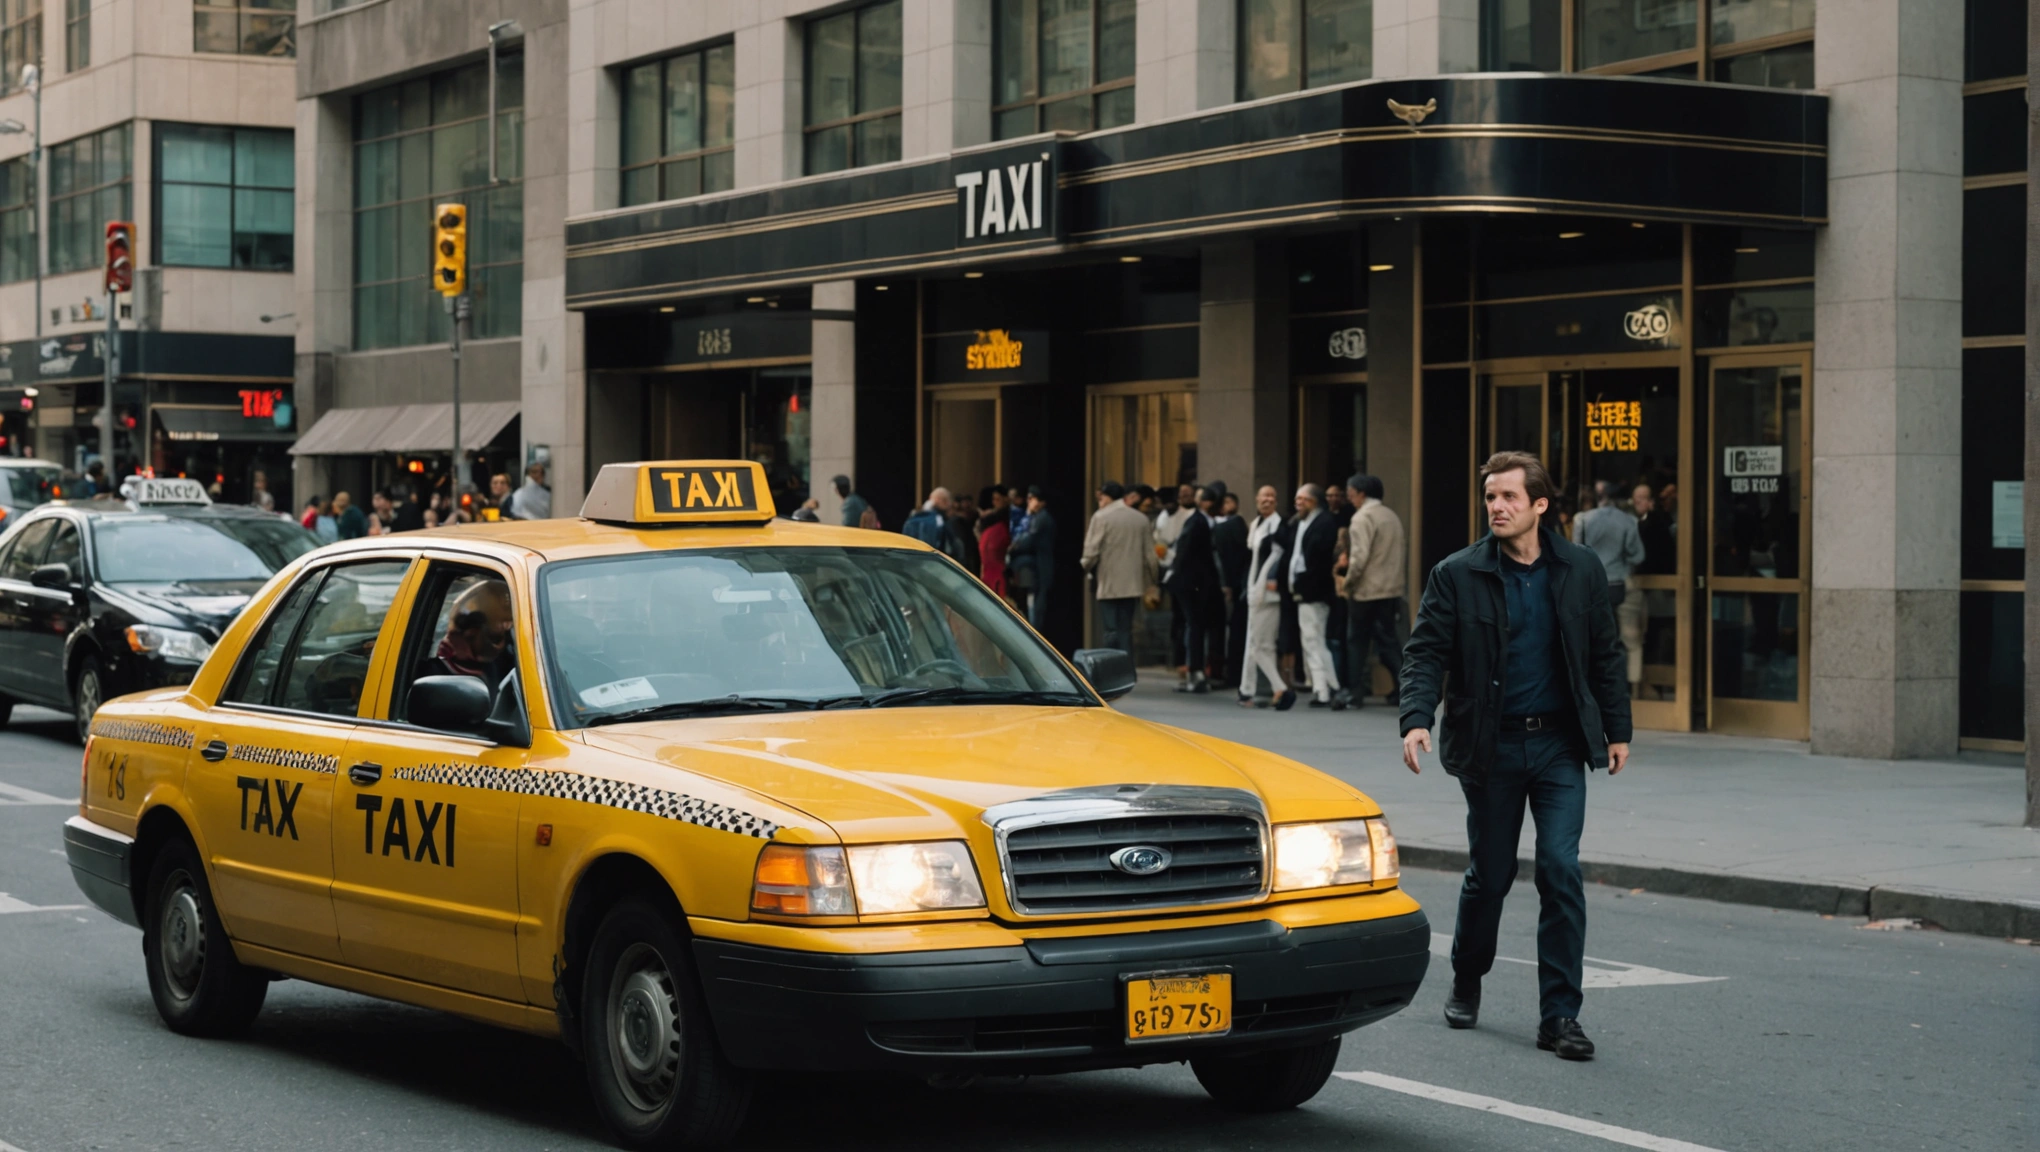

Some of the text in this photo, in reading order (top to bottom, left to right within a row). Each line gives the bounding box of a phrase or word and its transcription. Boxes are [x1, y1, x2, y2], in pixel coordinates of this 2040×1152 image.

[955, 161, 1043, 238] TAXI
[661, 471, 743, 508] TAXI
[237, 775, 304, 841] TAX
[356, 793, 457, 868] TAXI
